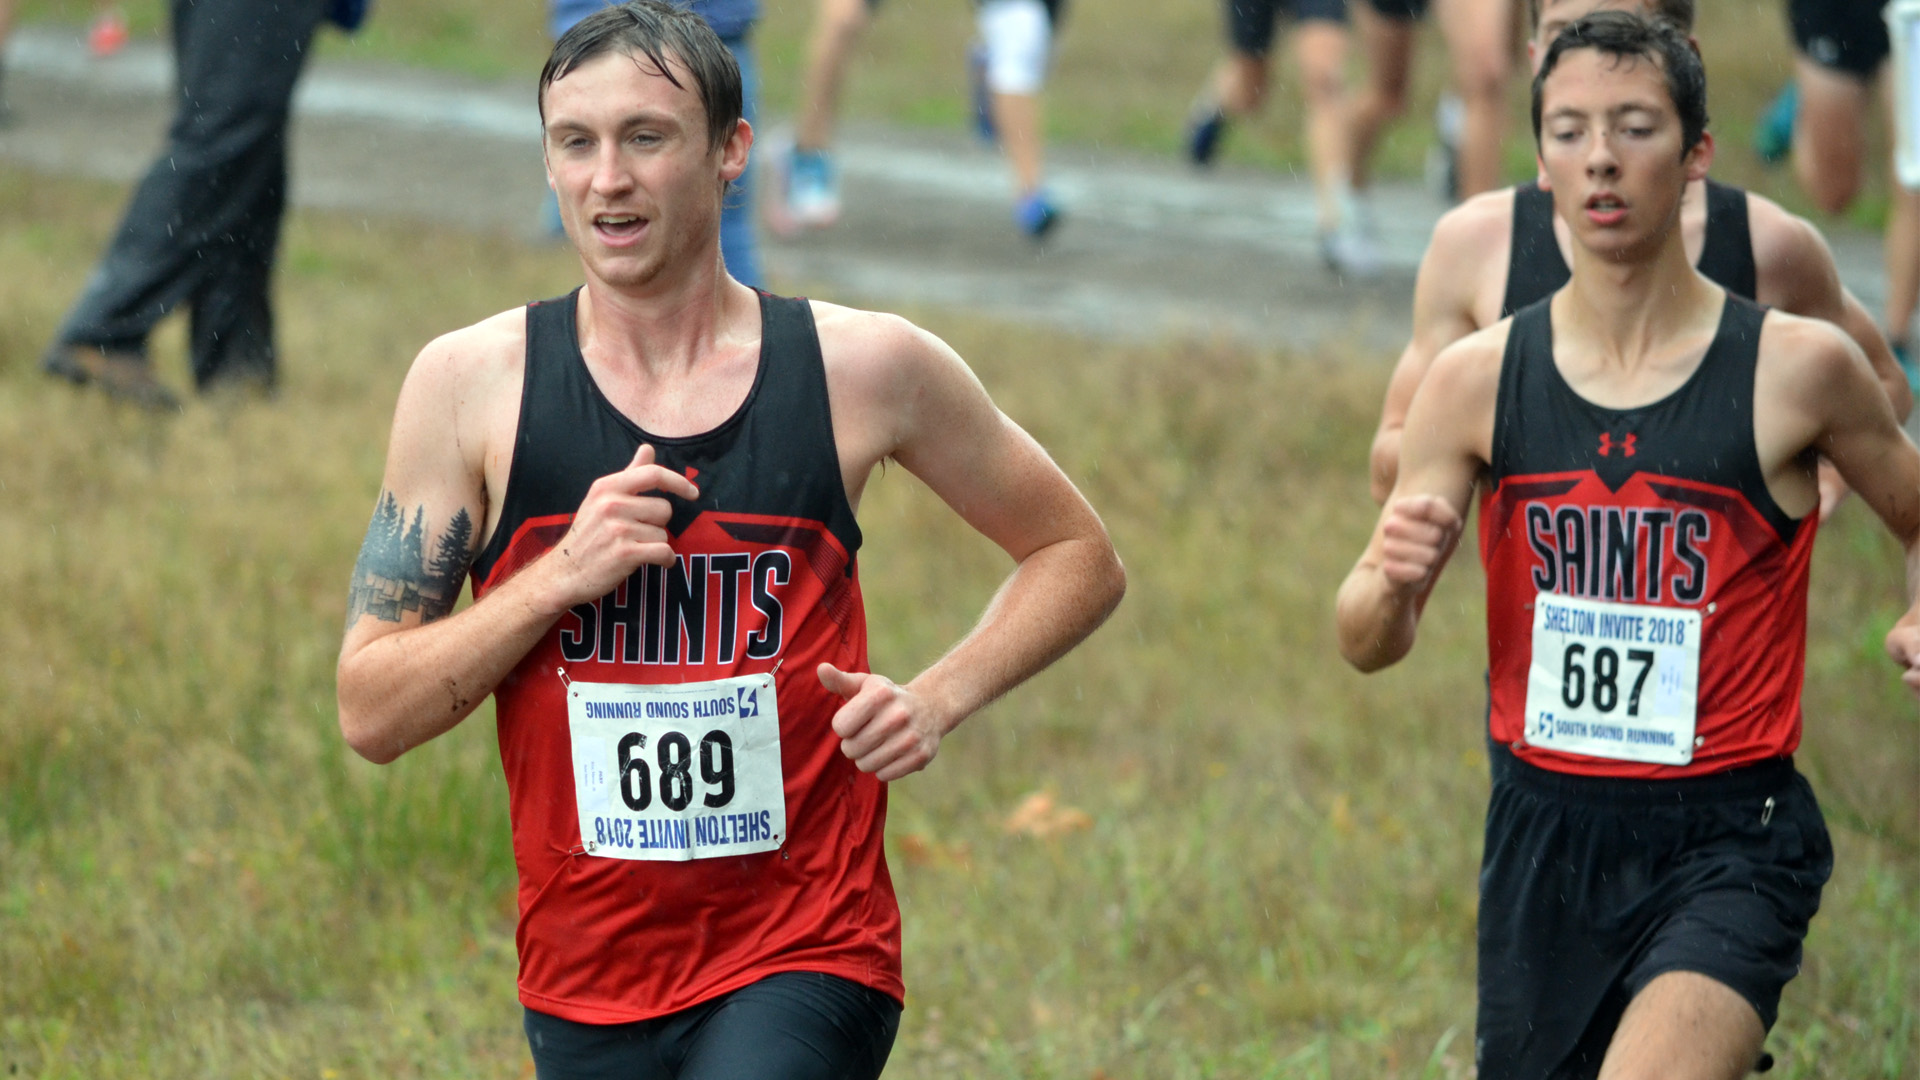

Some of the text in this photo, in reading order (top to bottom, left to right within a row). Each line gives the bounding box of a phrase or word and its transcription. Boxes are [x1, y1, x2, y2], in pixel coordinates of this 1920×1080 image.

[1526, 502, 1709, 604] SAINTS
[1544, 604, 1685, 646] SHELTON INVITE 2018
[1562, 642, 1655, 718] 687
[586, 696, 735, 719] SOUTH SOUND RUNNING
[1555, 720, 1676, 747] SOUTH SOUND RUNNING
[617, 729, 736, 812] 689
[594, 809, 771, 849] SHELTON INVITE 2018
